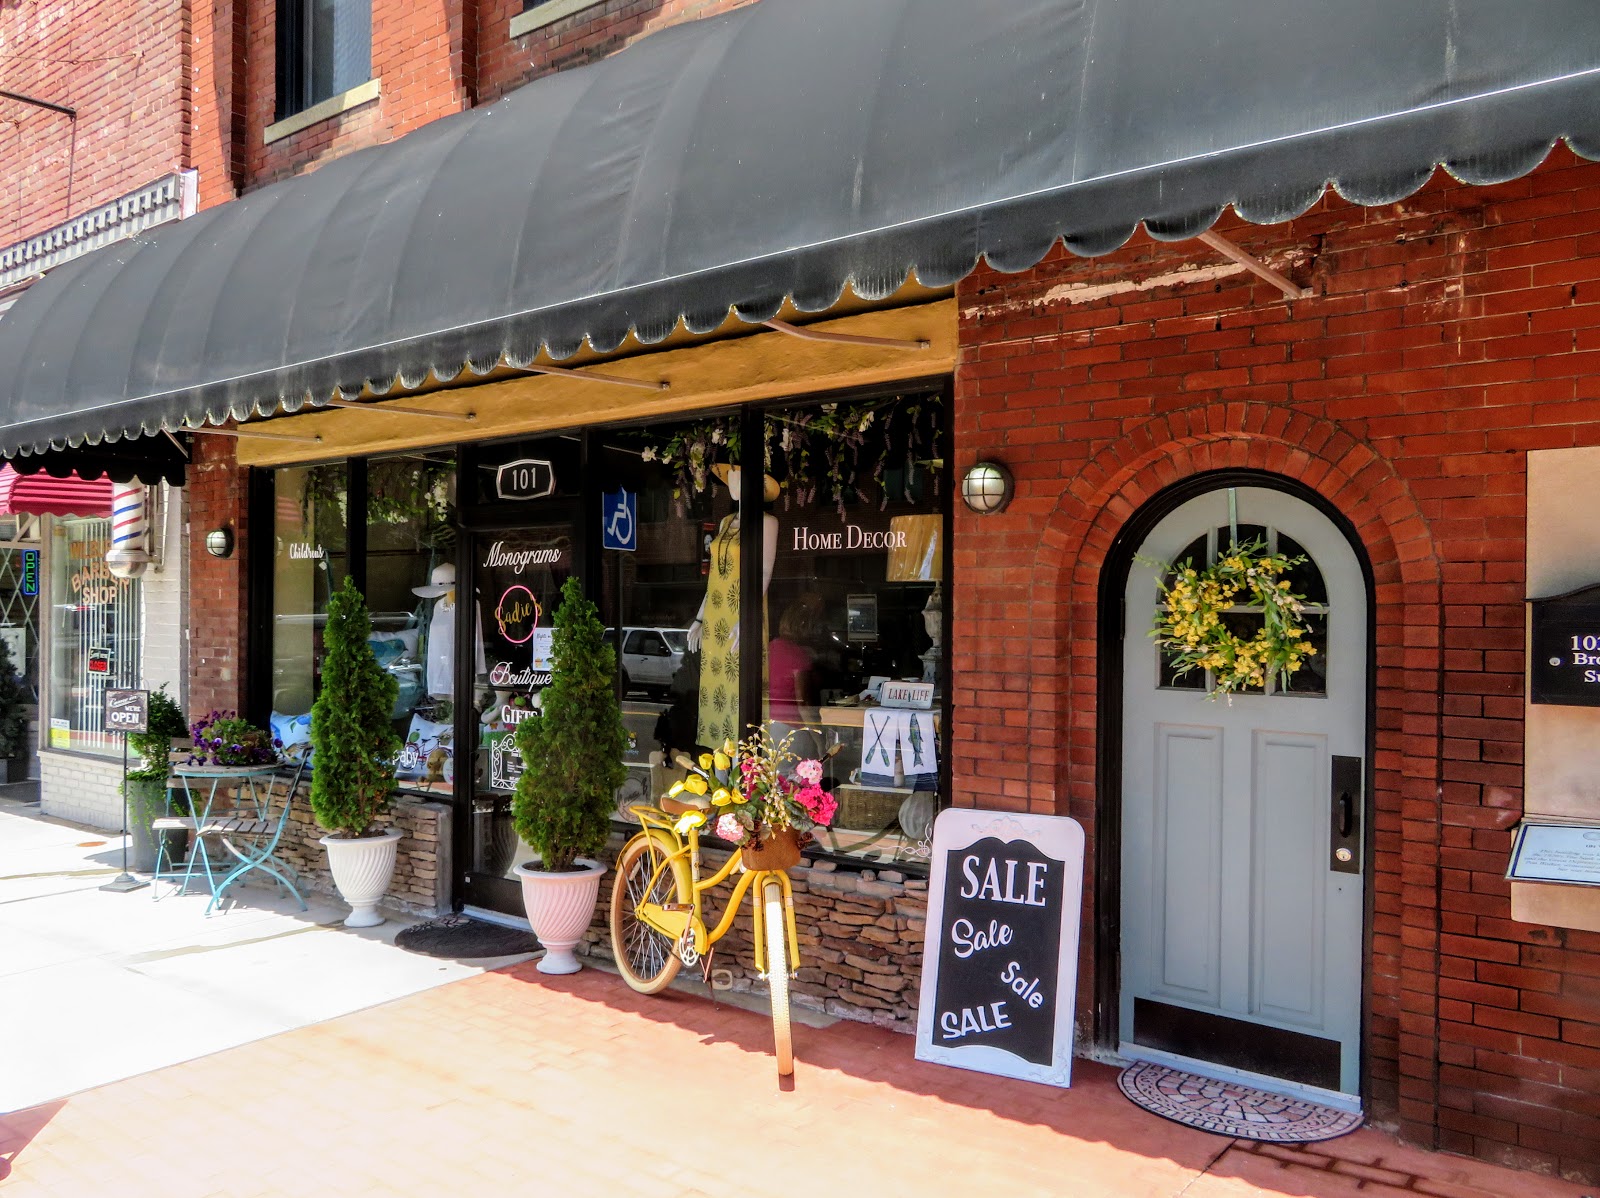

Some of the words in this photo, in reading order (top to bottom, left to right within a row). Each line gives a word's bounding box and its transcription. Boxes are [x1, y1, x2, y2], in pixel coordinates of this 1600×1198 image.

[512, 467, 537, 490] 101
[793, 527, 842, 550] HOME
[846, 525, 907, 549] DECOR
[25, 552, 36, 593] OPEN
[483, 540, 562, 574] Monograms
[82, 585, 117, 605] SHOP
[494, 593, 543, 635] Sadie's
[490, 661, 553, 692] Boutique
[888, 688, 908, 700] LAKE
[911, 689, 930, 701] LIFE
[111, 711, 140, 724] OPEN
[960, 855, 1048, 907] SALE
[951, 918, 1014, 959] Sale
[1000, 961, 1044, 1010] Sale
[941, 1001, 1013, 1040] SALE
